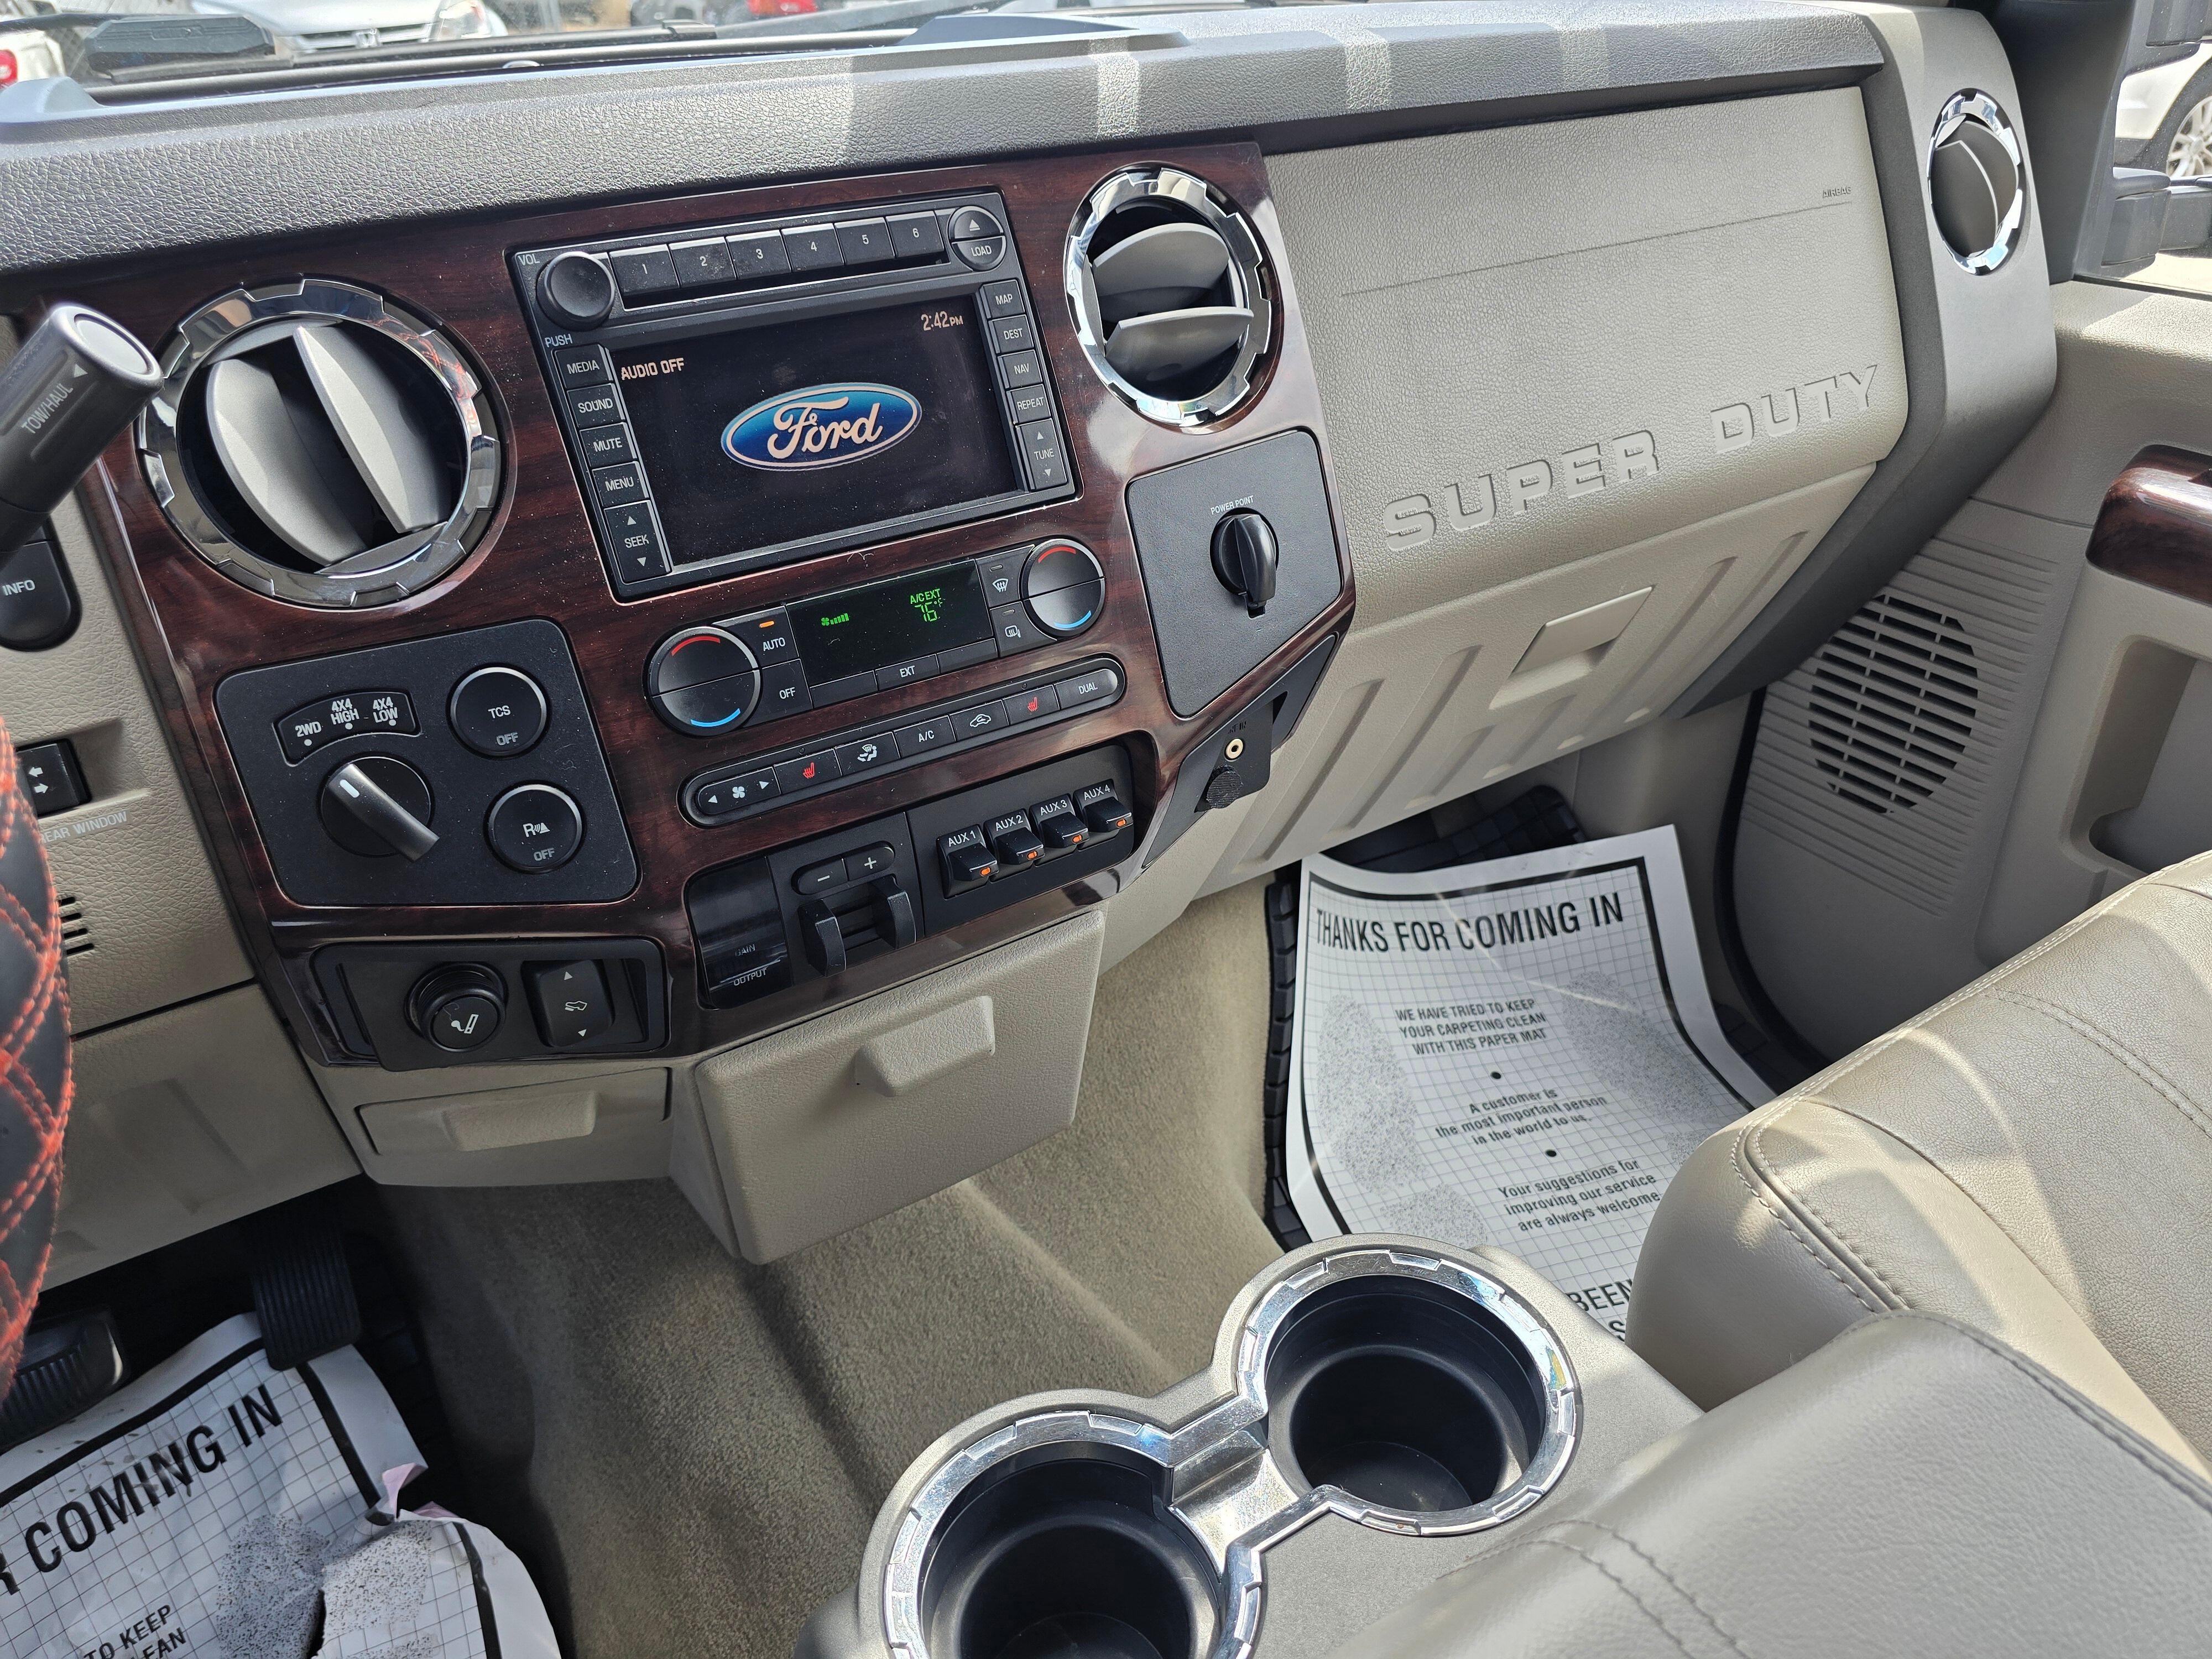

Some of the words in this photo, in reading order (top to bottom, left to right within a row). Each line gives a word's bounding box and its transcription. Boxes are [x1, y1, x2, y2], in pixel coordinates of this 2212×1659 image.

[1822, 186, 1851, 199] AIRBAG
[862, 234, 869, 245] 5
[912, 228, 920, 238] 6
[756, 248, 764, 259] 3
[810, 241, 817, 252] 4
[971, 245, 992, 257] LOAD
[518, 254, 540, 267] VOL
[700, 256, 708, 267] 2
[642, 264, 648, 275] 1
[995, 294, 1013, 305] MAP
[545, 333, 573, 349] PUSH
[1003, 328, 1022, 340] DEST
[567, 359, 600, 375] MEDIA
[621, 362, 658, 380] AUDIO
[661, 358, 685, 374] OFF
[1014, 363, 1030, 375] NAV
[20, 383, 74, 435] TOW/HAUL
[578, 398, 613, 414] SOUND
[1017, 397, 1044, 410] REPEAT
[768, 397, 883, 459] Ford
[593, 437, 623, 452] MUTE
[1034, 448, 1054, 461] TUNE
[1383, 429, 1660, 552] SUPER
[1710, 363, 1879, 455] DUTY
[605, 477, 634, 492] MENU
[1211, 502, 1234, 515] POWER
[1235, 495, 1253, 507] POINT
[624, 534, 650, 549] SEEK
[2, 579, 35, 596] INFO
[763, 638, 785, 651] AUTO
[900, 666, 915, 678] EXT
[779, 687, 795, 700] OFF
[1078, 682, 1098, 694] DUAL
[331, 698, 353, 712] 4X4
[373, 697, 393, 710] 4X4
[331, 708, 359, 724] HIGH
[373, 707, 398, 723] LOW
[488, 705, 511, 719] TCS
[295, 721, 321, 737] 2WD
[919, 731, 935, 742] A/C
[496, 732, 519, 745] OFF
[1083, 787, 1103, 801] AUX
[1104, 784, 1110, 794] 4
[1040, 802, 1059, 816] AUX
[1060, 799, 1067, 808] 3
[72, 811, 127, 834] WINDOW
[995, 817, 1015, 831] AUX
[1016, 815, 1024, 825] 2
[948, 832, 969, 847] AUX
[972, 830, 976, 839] 1
[533, 848, 555, 861] OFF
[1316, 909, 1388, 952] THANKS
[1395, 921, 1450, 952] FOR
[1456, 901, 1580, 950] COMING
[1590, 891, 1624, 927] IN
[734, 967, 769, 985] OUTPUT
[1395, 1009, 1416, 1021] WE
[1417, 1006, 1448, 1021] HAVE
[1449, 1004, 1485, 1018] TRIED
[1486, 1002, 1503, 1014] TO
[1505, 998, 1535, 1011] KEEP
[1399, 1025, 1435, 1039] YOUR
[1438, 1019, 1504, 1036] CARPETING
[1505, 1012, 1547, 1028] CLEAN
[1412, 1042, 1446, 1055] WITH
[1447, 1038, 1476, 1051] THIS
[1478, 1032, 1519, 1047] PAPER
[1520, 1028, 1547, 1041] MAT
[1469, 1103, 1480, 1114] A
[1481, 1092, 1541, 1111] customer
[1543, 1089, 1558, 1099] is
[1435, 1126, 1458, 1138] the
[1461, 1116, 1495, 1133] most
[1496, 1103, 1562, 1123] important
[1563, 1096, 1607, 1112] person
[1472, 1135, 1488, 1145] in
[1488, 1130, 1511, 1141] the
[1514, 1119, 1552, 1135] world
[1553, 1116, 1568, 1126] to
[1498, 1184, 1531, 1198] Your
[1534, 1164, 1618, 1191] suggestions
[1618, 1160, 1640, 1172] for
[1504, 1194, 1578, 1215] improving
[1579, 1188, 1603, 1201] our
[1604, 1175, 1656, 1194] service
[1518, 1218, 1542, 1232] are
[1545, 1208, 1595, 1225] always
[1597, 1191, 1661, 1214] welcome
[25, 1425, 227, 1573] COMING
[227, 1384, 283, 1447] IN
[119, 1605, 170, 1650] KEEP
